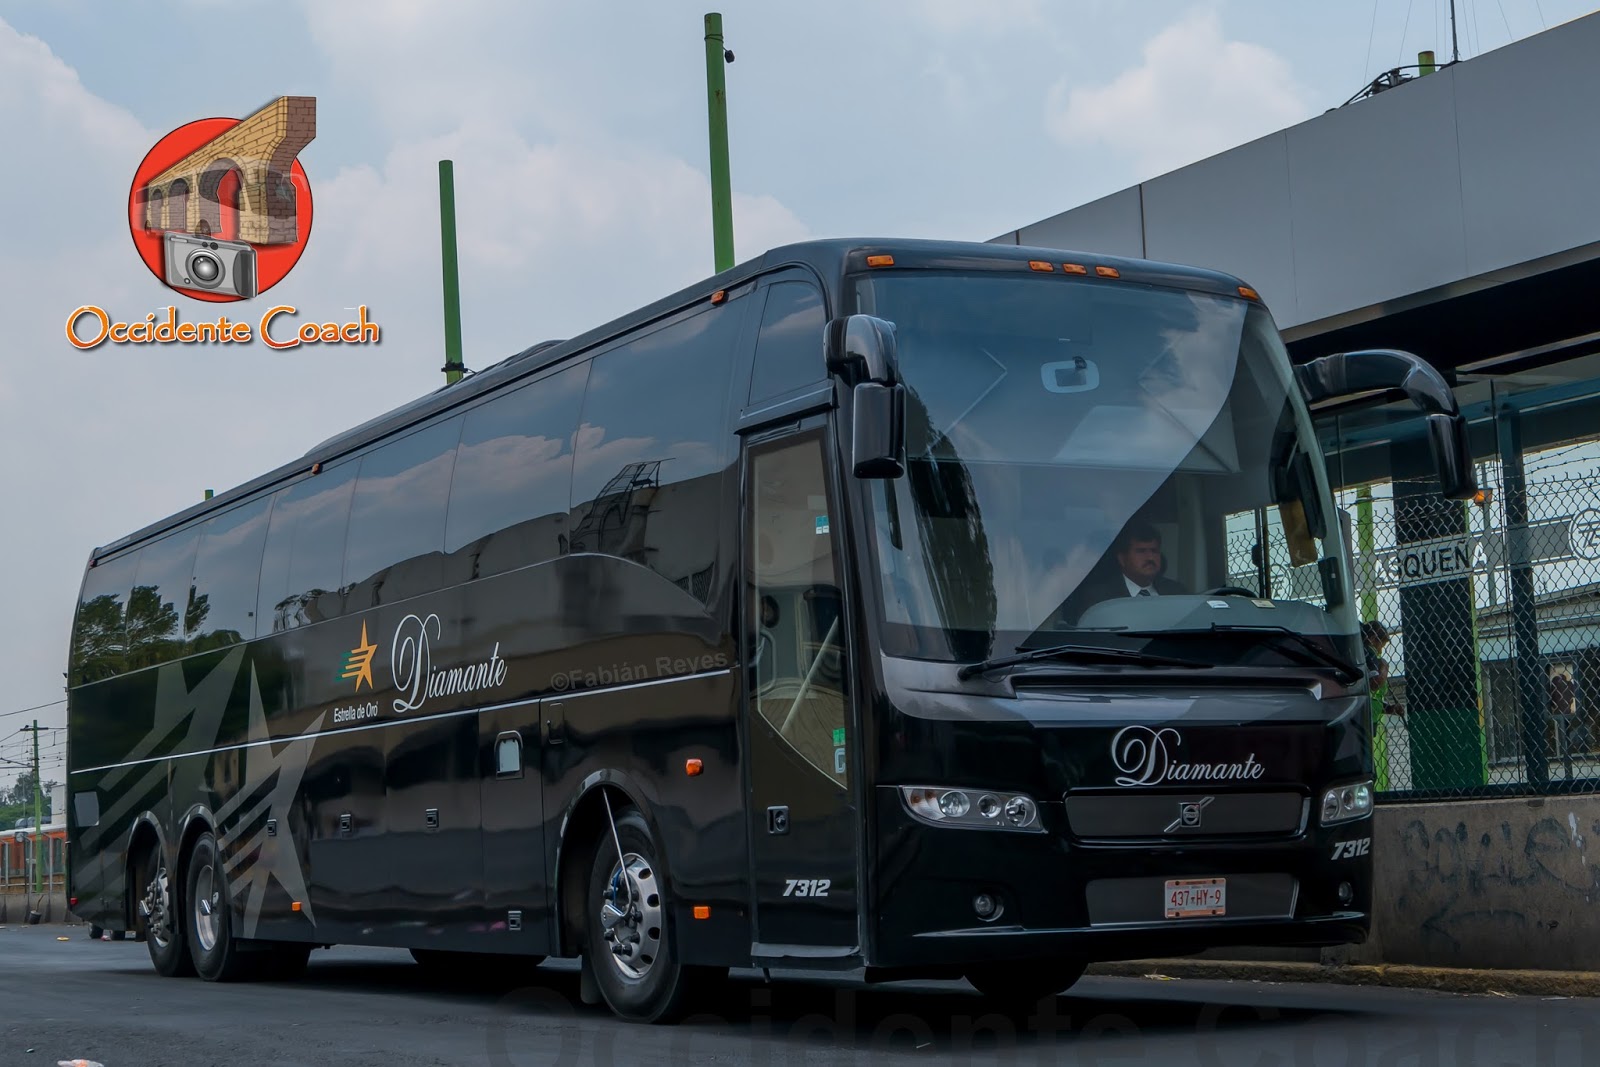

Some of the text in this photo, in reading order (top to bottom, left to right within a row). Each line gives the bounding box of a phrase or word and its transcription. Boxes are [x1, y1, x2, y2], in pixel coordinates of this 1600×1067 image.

[391, 613, 507, 712] Diamante
[333, 702, 378, 723] Estrella de Oro
[1111, 725, 1266, 787] Diamante
[1331, 837, 1371, 861] 7312
[782, 879, 831, 897] 7312
[1171, 889, 1222, 907] 437-HY-9
